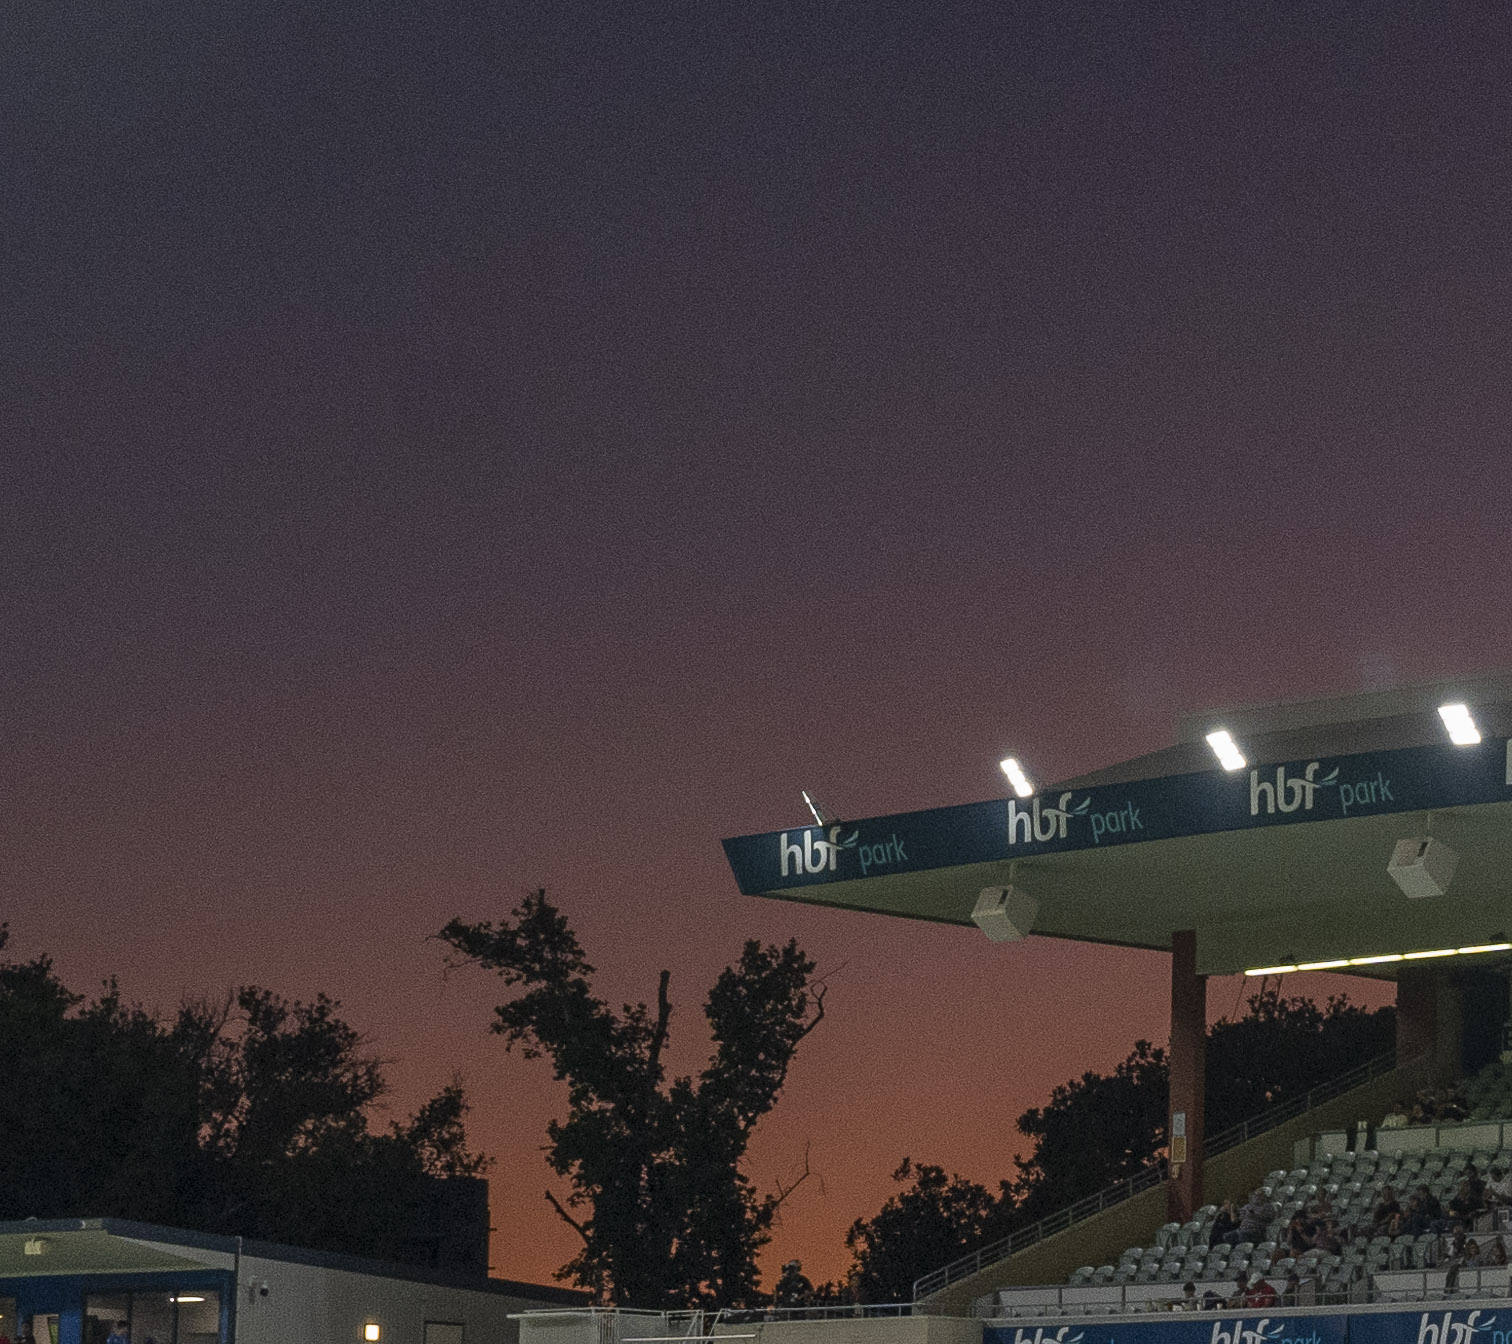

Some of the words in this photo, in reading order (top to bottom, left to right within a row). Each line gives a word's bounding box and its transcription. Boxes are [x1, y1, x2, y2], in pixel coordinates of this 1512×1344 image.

[1250, 762, 1321, 816] hbf
[1339, 773, 1394, 816] park
[1008, 791, 1074, 845] hbf
[1090, 801, 1144, 845] park
[780, 827, 843, 876] hbf
[858, 833, 909, 875] park
